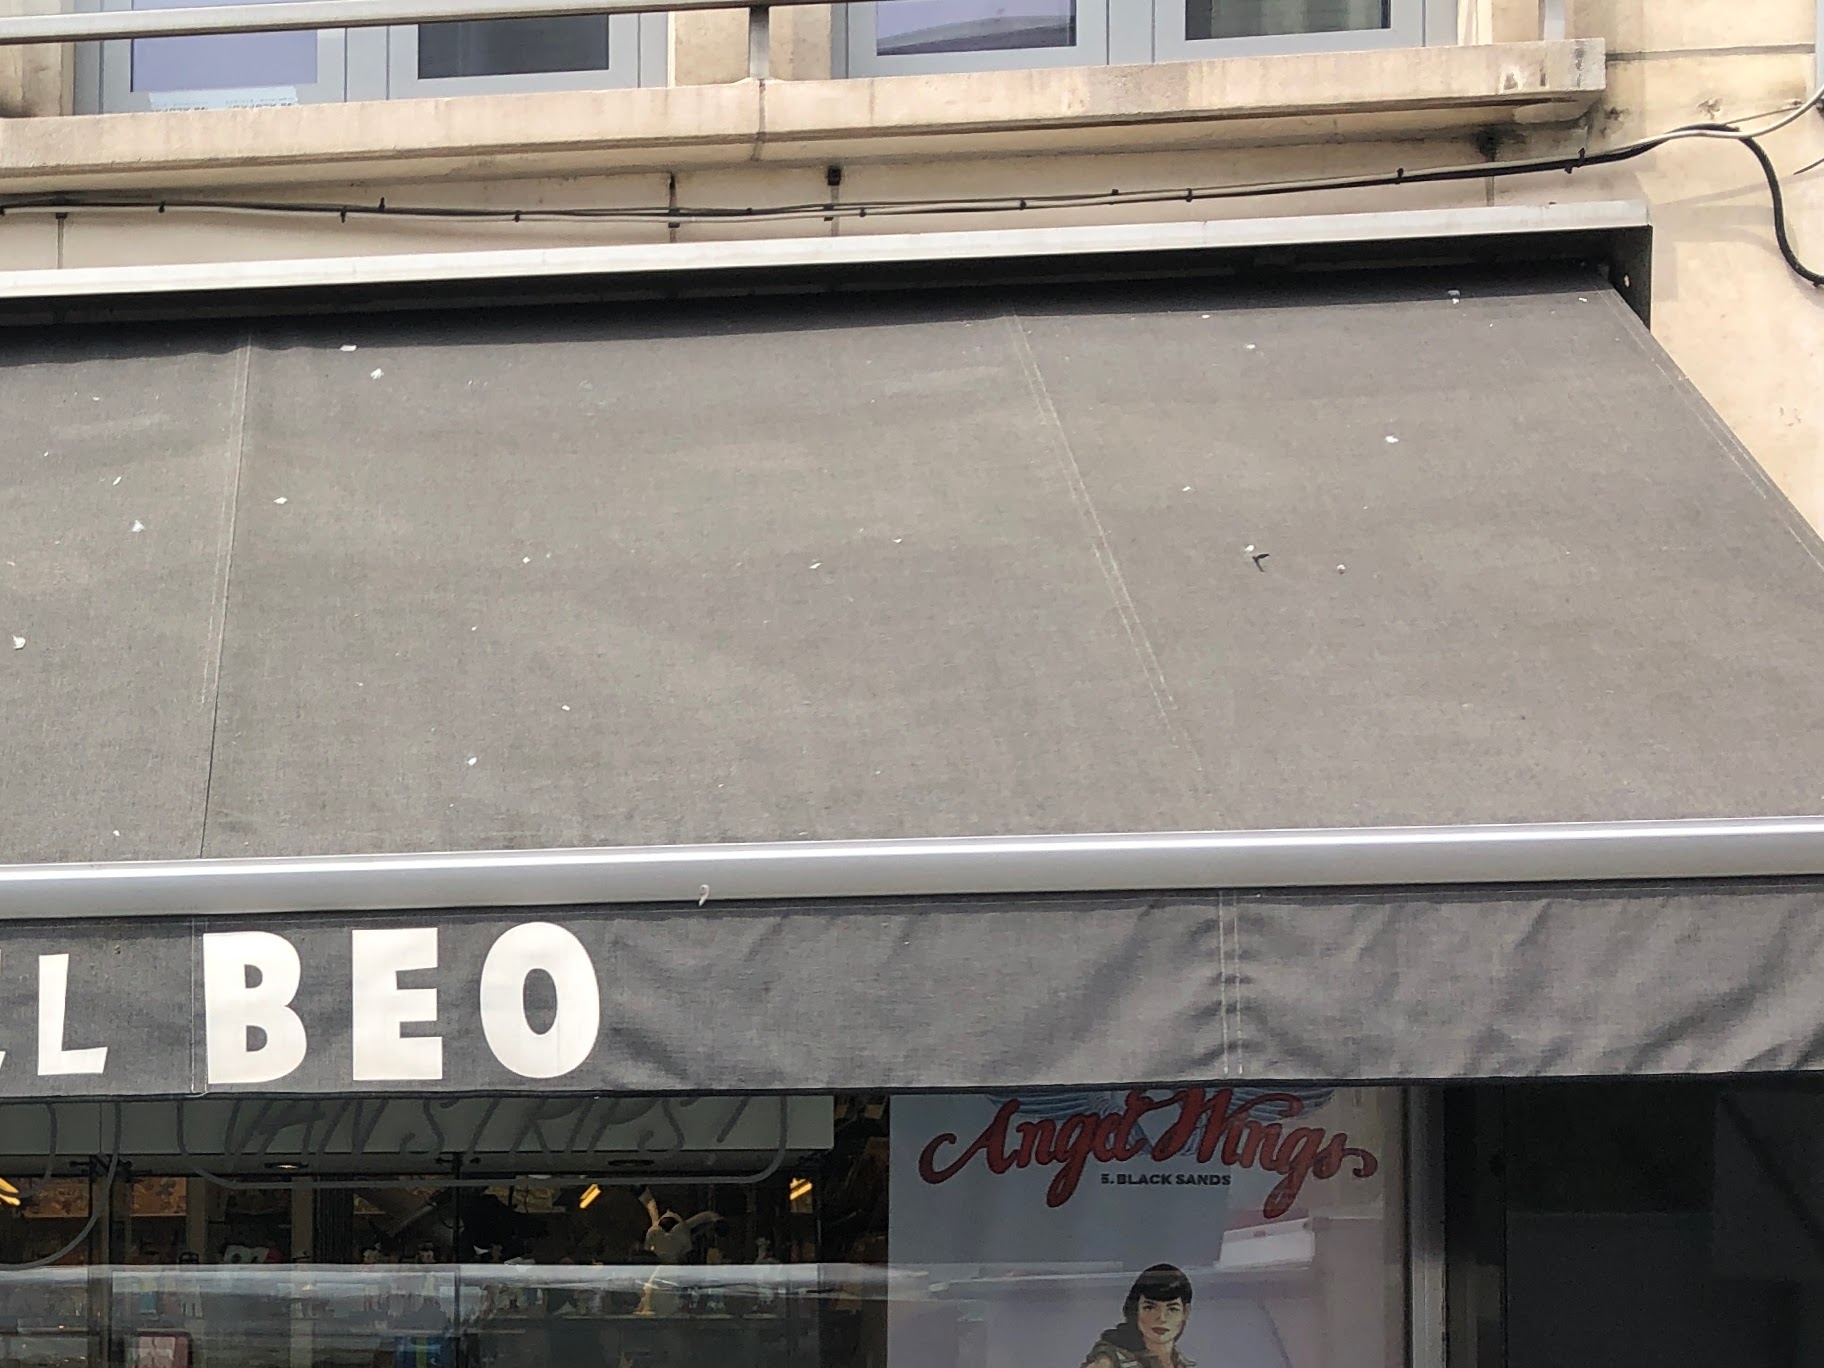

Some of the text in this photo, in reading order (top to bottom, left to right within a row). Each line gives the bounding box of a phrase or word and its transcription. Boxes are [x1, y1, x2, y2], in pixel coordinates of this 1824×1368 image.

[203, 922, 599, 1084] BEO
[1116, 1173, 1172, 1185] BLACK
[1176, 1174, 1232, 1186] SANDS
